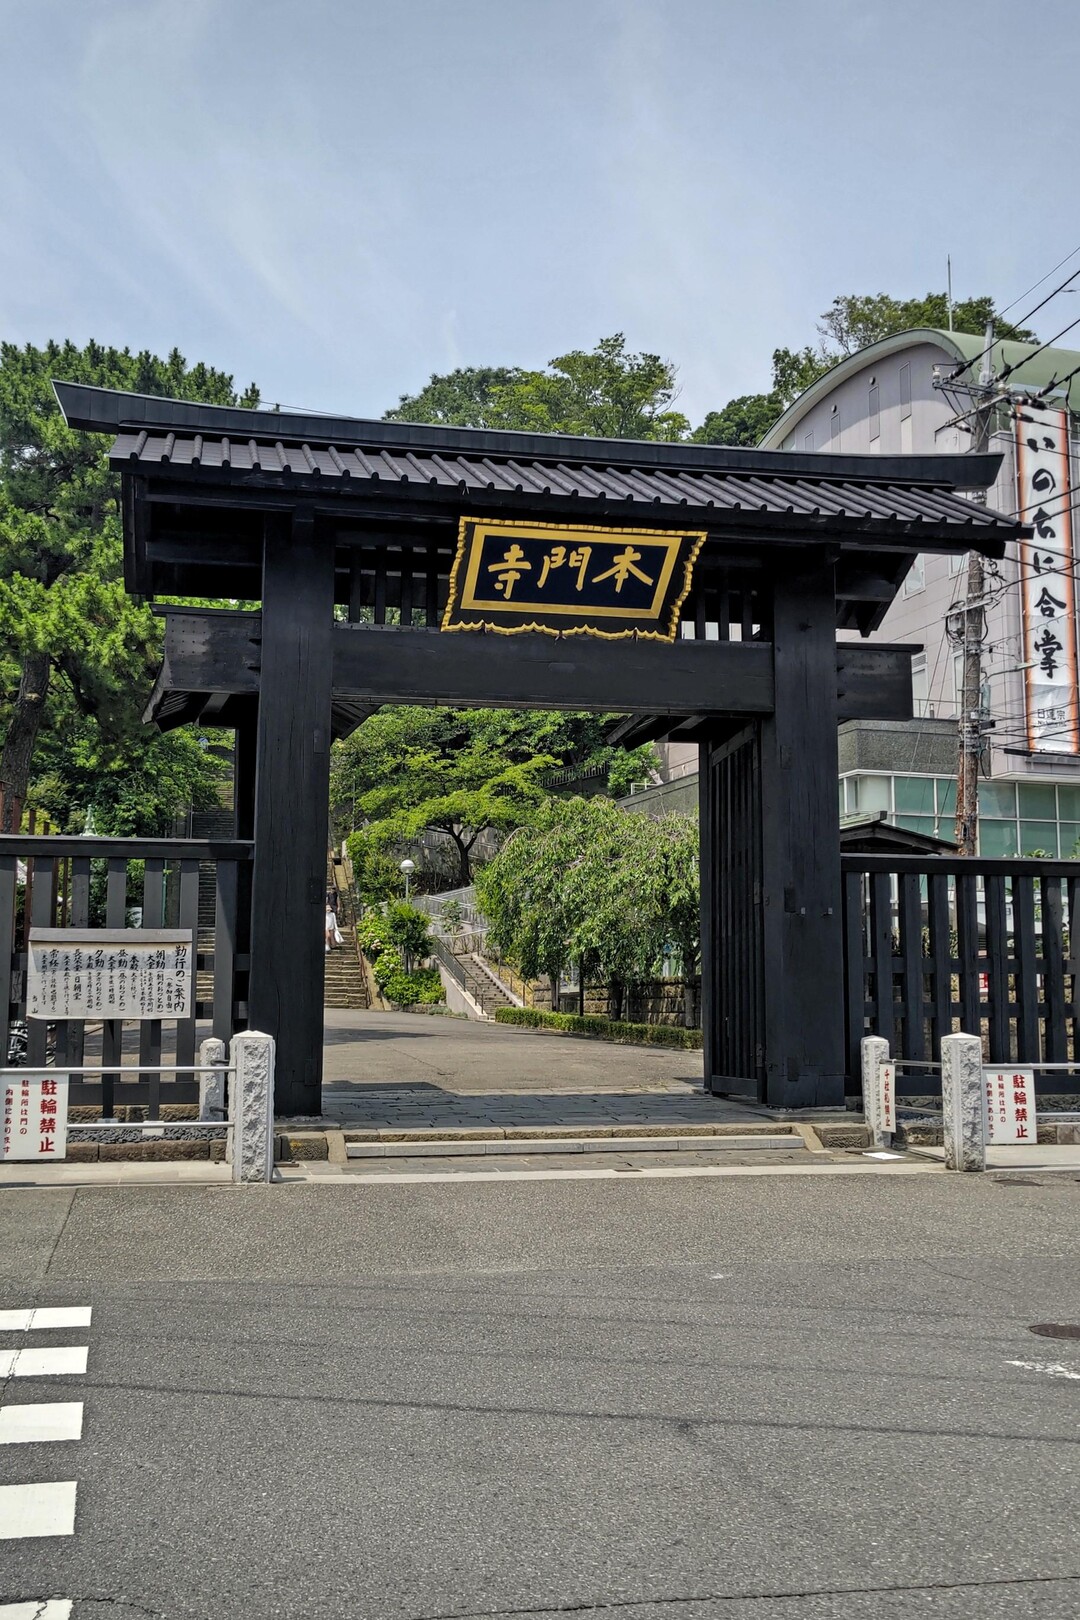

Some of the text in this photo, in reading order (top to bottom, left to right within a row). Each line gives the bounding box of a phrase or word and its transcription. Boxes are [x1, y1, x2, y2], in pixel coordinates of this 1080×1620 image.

[488, 543, 654, 600] 本門寺
[1028, 437, 1066, 680] いのちに合掌
[1037, 708, 1066, 721] 日蓮宗
[174, 945, 187, 1013] 勤行のご案内
[3, 1089, 14, 1153] 内側にあります
[19, 1079, 30, 1135] 駐輪所は門の
[38, 1079, 58, 1153] 駐輪禁止
[1012, 1074, 1029, 1139] 駐輪禁止
